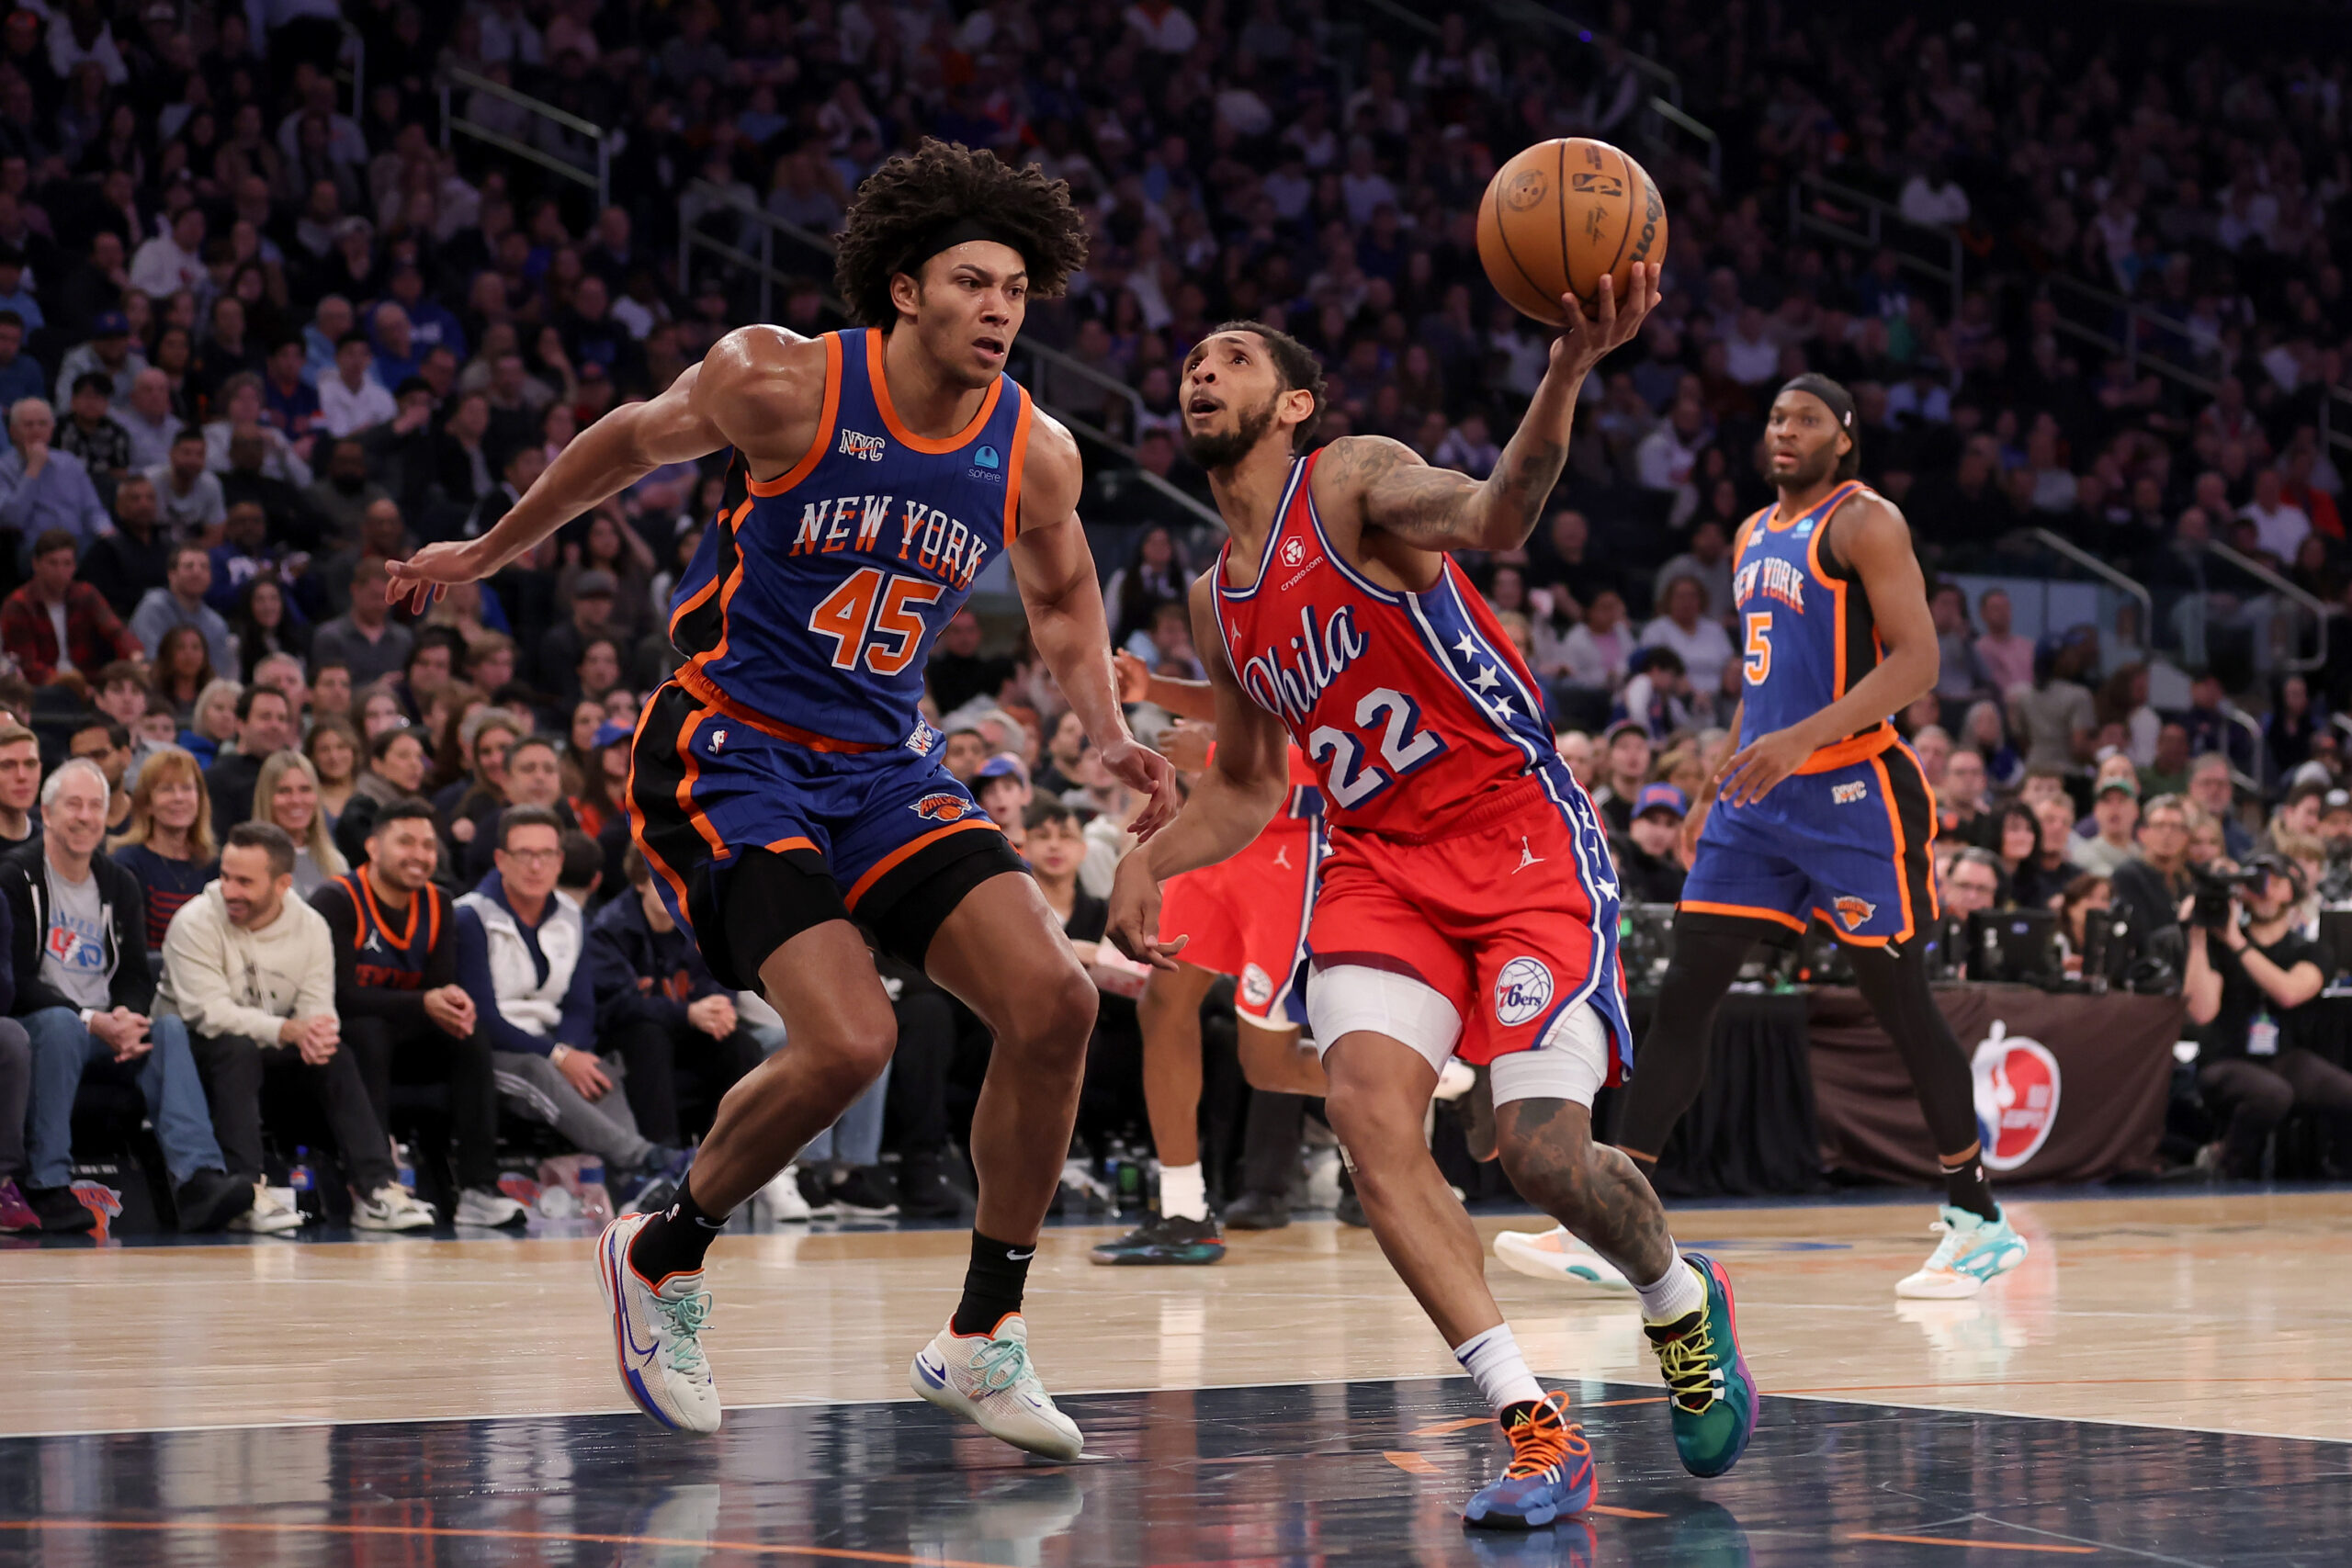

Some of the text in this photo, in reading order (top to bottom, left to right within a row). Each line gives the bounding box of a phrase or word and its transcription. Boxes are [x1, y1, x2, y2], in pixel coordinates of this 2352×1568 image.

[838, 428, 886, 461] NYC
[967, 467, 1001, 483] sphere
[789, 495, 988, 591] NEW YORK
[1281, 556, 1324, 592] crypto.com
[1761, 556, 1804, 615] YORK
[808, 566, 947, 676] 45
[1743, 611, 1773, 685] 5
[1243, 604, 1370, 725] Phila
[1309, 687, 1449, 811] 22
[1498, 983, 1543, 1008] 76ers
